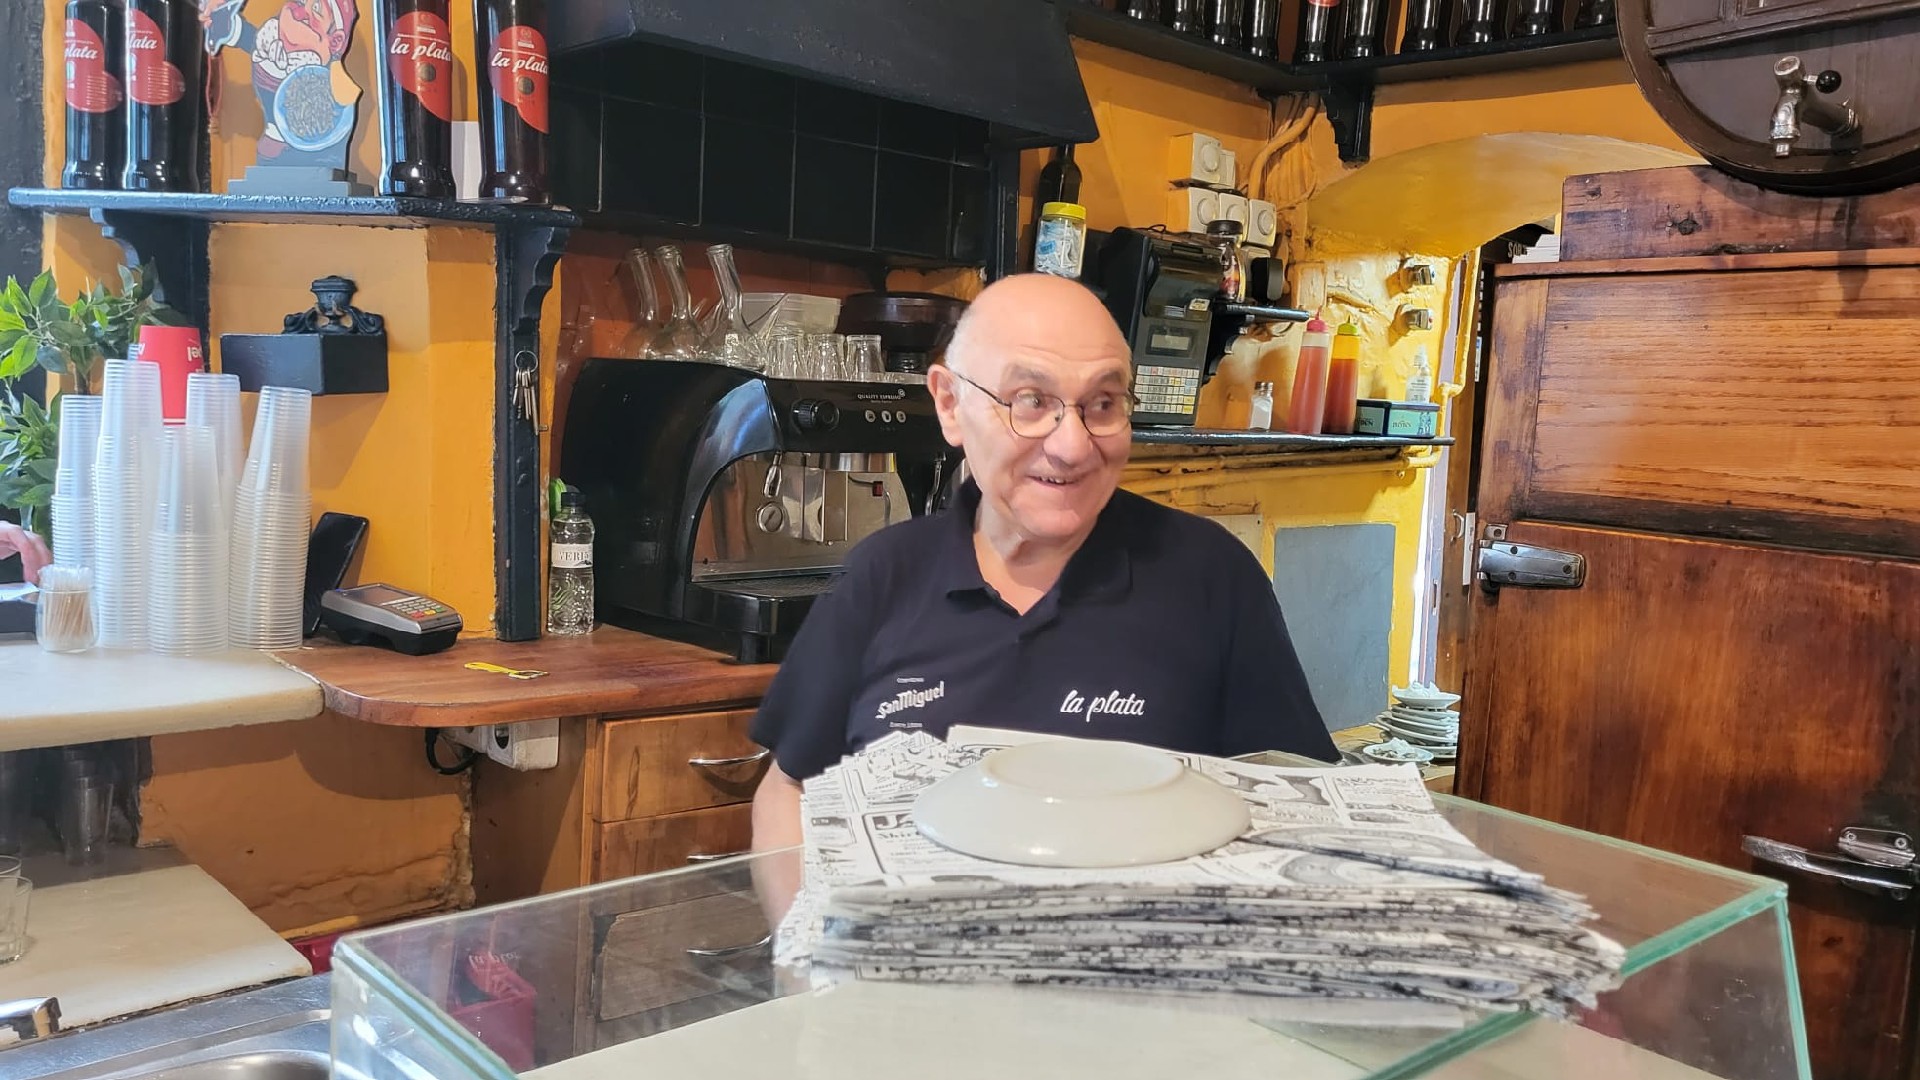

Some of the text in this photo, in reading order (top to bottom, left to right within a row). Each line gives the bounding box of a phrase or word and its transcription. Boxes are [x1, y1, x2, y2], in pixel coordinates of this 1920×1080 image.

[390, 37, 410, 54] la
[491, 51, 510, 67] la
[1060, 690, 1145, 722] la plata
